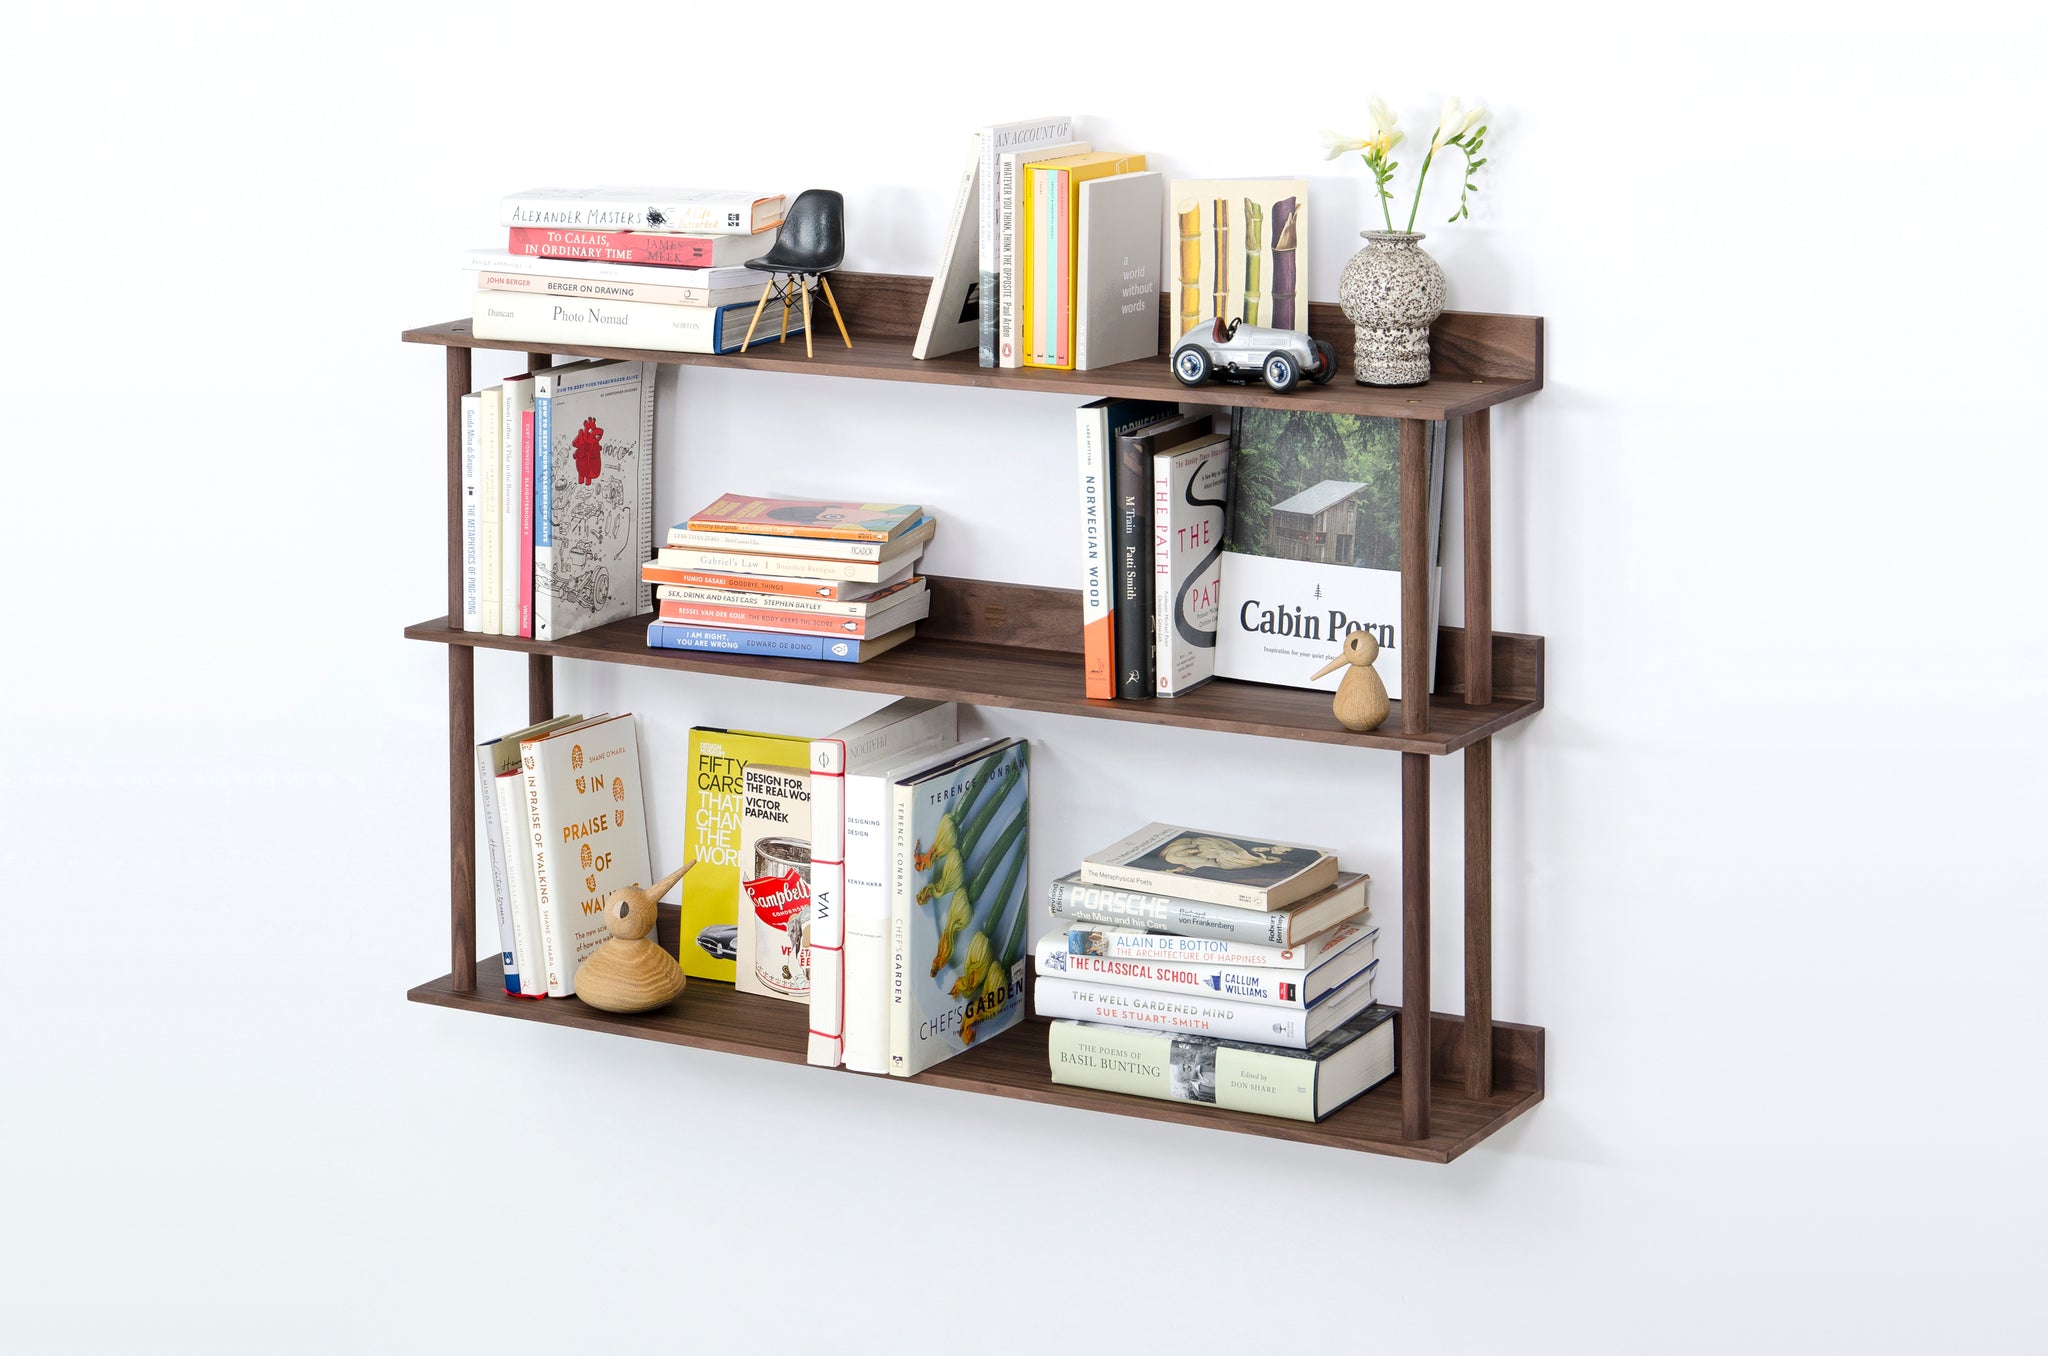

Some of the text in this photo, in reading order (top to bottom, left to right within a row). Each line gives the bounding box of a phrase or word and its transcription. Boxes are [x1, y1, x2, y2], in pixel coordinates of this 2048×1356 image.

[995, 122, 1069, 148] AN ACCOUNT OF
[512, 206, 642, 225] ALEXANDER MASTERS
[565, 232, 610, 247] CALAIS,
[645, 238, 684, 251] JAMES
[525, 244, 633, 260] IN ORDINARY TIME
[646, 251, 682, 263] MEEK
[1002, 161, 1012, 338] WHATEVER YOU THINK, THINK THE OPPOSITE Paul Arden
[1123, 256, 1128, 266] a
[1122, 265, 1145, 280] world
[486, 277, 531, 287] JOHN BERGER
[547, 282, 634, 297] BERGER ON DRAWING
[1122, 282, 1153, 297] without
[487, 308, 514, 318] Duncan
[553, 305, 629, 326] Photo Nomad
[1121, 299, 1145, 314] words
[671, 321, 700, 330] NORTON
[466, 409, 475, 429] Guido
[542, 418, 548, 429] TO
[467, 429, 475, 446] Mina
[466, 454, 475, 478] Sospiro
[1125, 495, 1136, 534] M Train
[1156, 477, 1169, 575] THE PATH
[467, 518, 475, 566] METAPHYSICS
[1085, 475, 1100, 608] NORWEGIAN WOOD
[1178, 520, 1209, 552] THE
[467, 566, 475, 575] OF
[700, 555, 759, 569] Gabriel's Law
[683, 575, 726, 585] FUMIO SASAKI
[1126, 546, 1137, 600] Patti Smith
[467, 576, 475, 615] PING-PONG
[761, 583, 784, 591] THINGS
[667, 590, 758, 605] SEX, DRINK AND FAST CARS
[763, 599, 822, 611] STEPHEN BAYLEY
[678, 607, 746, 620] BESSEL VAN DER KOLK
[1240, 599, 1320, 640] Cabin
[746, 639, 778, 649] EDWARD
[790, 643, 813, 651] BONO
[589, 747, 626, 764] SHANE O'MARA
[699, 754, 748, 777] FIFTY
[591, 774, 605, 793] IN
[698, 772, 743, 795] CARS
[746, 771, 803, 791] DESIGN FOR
[930, 758, 1026, 806] TERENCE CONRAN
[746, 782, 763, 794] THE
[765, 785, 788, 799] REAL
[698, 790, 742, 813] THAT
[745, 796, 781, 811] VICTOR
[745, 807, 789, 824] PAPANEK
[847, 817, 881, 827] DESIGNING
[563, 814, 609, 844] PRAISE
[696, 826, 731, 848] THE
[847, 829, 869, 838] DESIGN
[528, 775, 549, 904] IN PRAISE OF WALKING
[895, 802, 905, 895] TERENCE CONRAN
[595, 852, 612, 872] OF
[1087, 869, 1153, 886] The Metaphysical Poets
[817, 891, 830, 920] WA
[1051, 883, 1059, 914] Revised
[1056, 886, 1065, 913] Edition
[1070, 886, 1171, 920] PORSCHE
[1192, 917, 1235, 932] Frankenberg
[1268, 915, 1277, 942] Robert
[1276, 914, 1285, 944] Bentley
[1116, 935, 1228, 953] ALAIN DE BOTTON
[1116, 948, 1267, 965] THE ARCHITECTURE OF HAPPINESS
[1069, 956, 1199, 985] THE CLASSICAL SCHOOL
[1224, 973, 1260, 986] CALLUM
[1224, 983, 1268, 999] WILLIAMS
[919, 1005, 963, 1041] CHEF'S
[965, 977, 1023, 1019] GARDEN
[1072, 990, 1235, 1021] THE WELL GARDENED MIND
[1096, 1007, 1210, 1031] SUE STUART-SMITH
[1078, 1043, 1143, 1060] THE POEMS OF
[1060, 1051, 1161, 1078] BASIL BUNTING
[1231, 1080, 1277, 1094] DON SHARE
